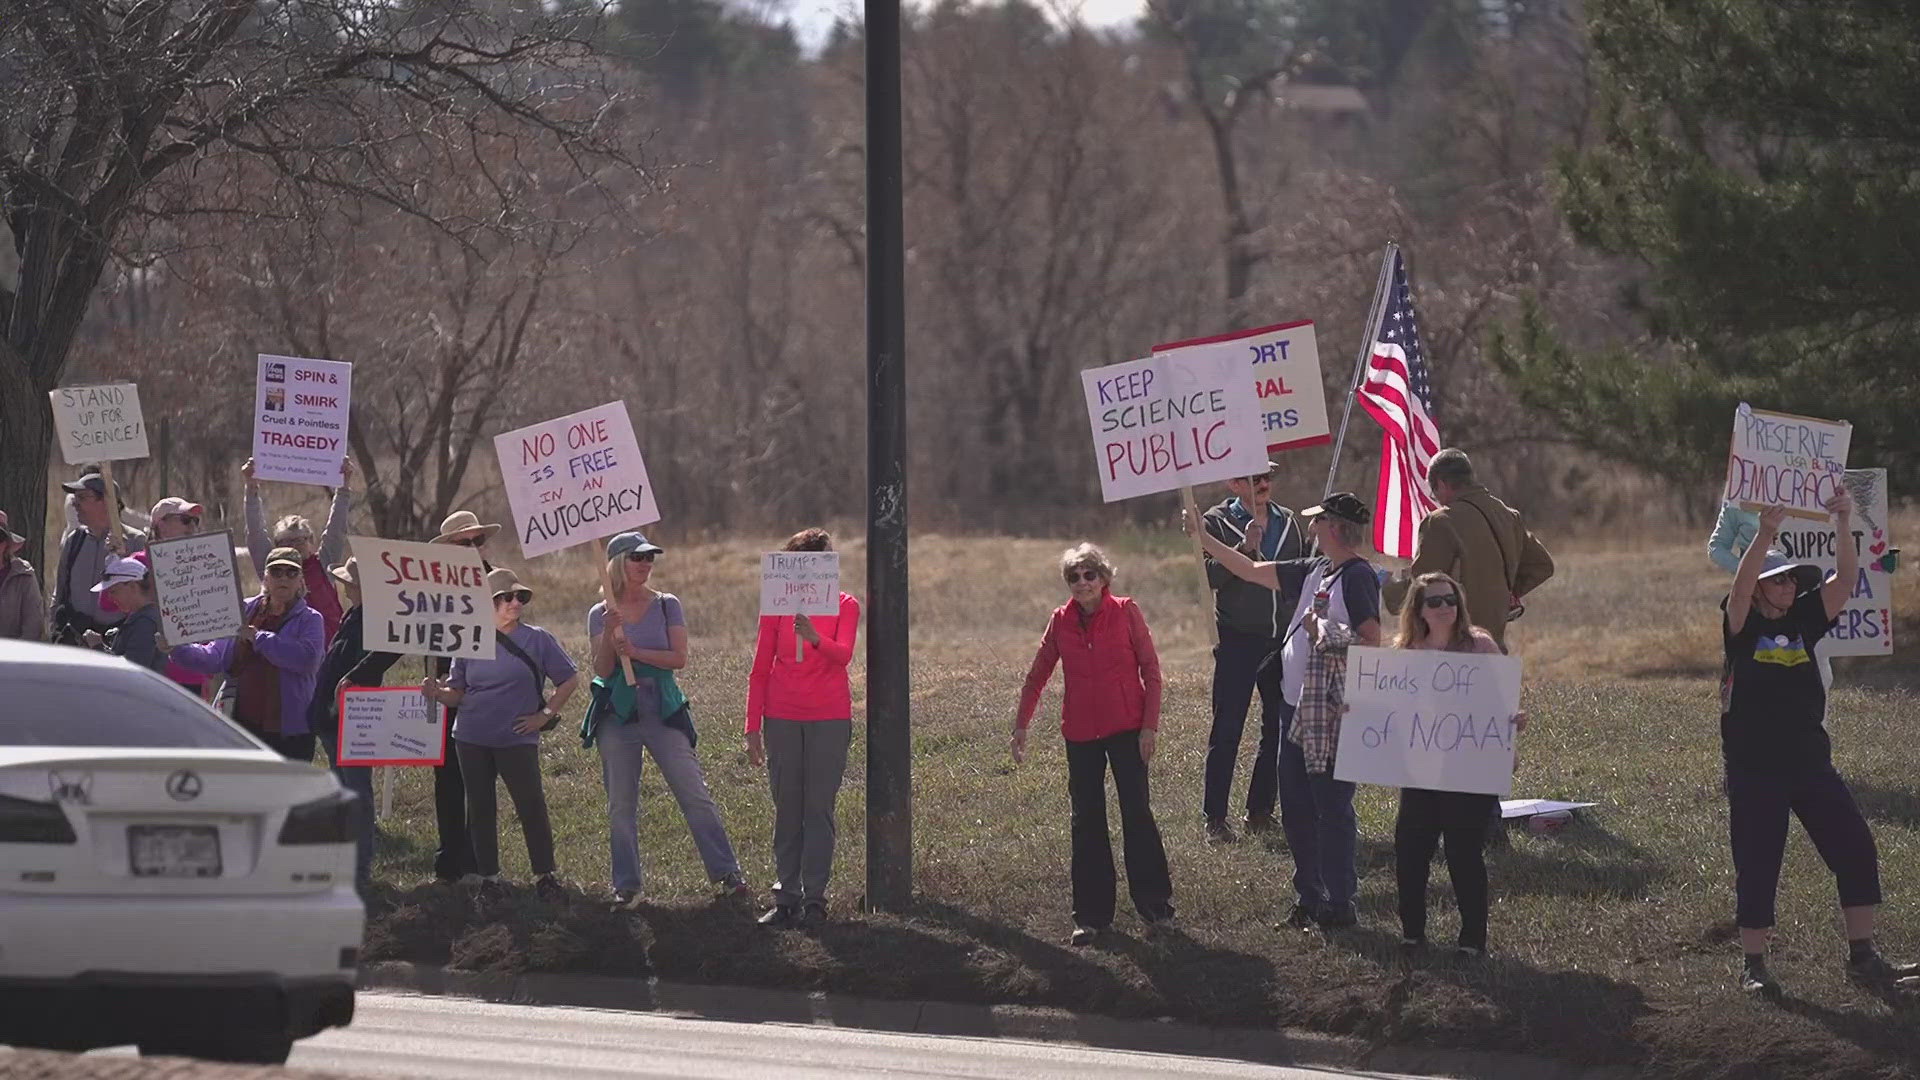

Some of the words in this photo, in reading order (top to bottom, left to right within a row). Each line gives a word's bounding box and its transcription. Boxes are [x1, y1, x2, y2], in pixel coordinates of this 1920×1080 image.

[1249, 340, 1290, 365] RT
[294, 369, 326, 383] SPIN
[328, 373, 338, 385] &
[1097, 369, 1154, 405] KEEP
[1256, 377, 1293, 398] AL
[62, 387, 124, 408] STAND
[294, 394, 338, 408] SMIRK
[1102, 389, 1227, 433] SCIENCE
[79, 411, 95, 426] UP
[101, 408, 124, 424] FOR
[262, 414, 287, 424] Cruel
[288, 417, 296, 426] &
[298, 418, 340, 430] Pointless
[1261, 408, 1299, 432] RS
[71, 422, 140, 449] SCIENCE!
[261, 431, 340, 451] TRAGEDY
[522, 433, 556, 466] NO
[568, 420, 609, 450] ONE
[1739, 409, 1836, 459] PRESERVE
[1106, 420, 1232, 481] PUBLIC
[1785, 455, 1808, 470] USA
[530, 465, 555, 484] IS
[568, 447, 618, 478] FREE
[540, 487, 564, 504] IN
[582, 476, 604, 492] AN
[524, 485, 643, 544] AUTOCRACY
[1780, 530, 1865, 559] SUPPOT
[380, 551, 483, 588] SCIENCE
[785, 582, 817, 595] HURTS
[396, 590, 474, 616] SAVES
[388, 620, 482, 652] LIVES!
[1358, 655, 1418, 695] Hands
[1432, 661, 1480, 696] Off
[1361, 710, 1396, 748] of
[1410, 712, 1514, 752] NOAA!
